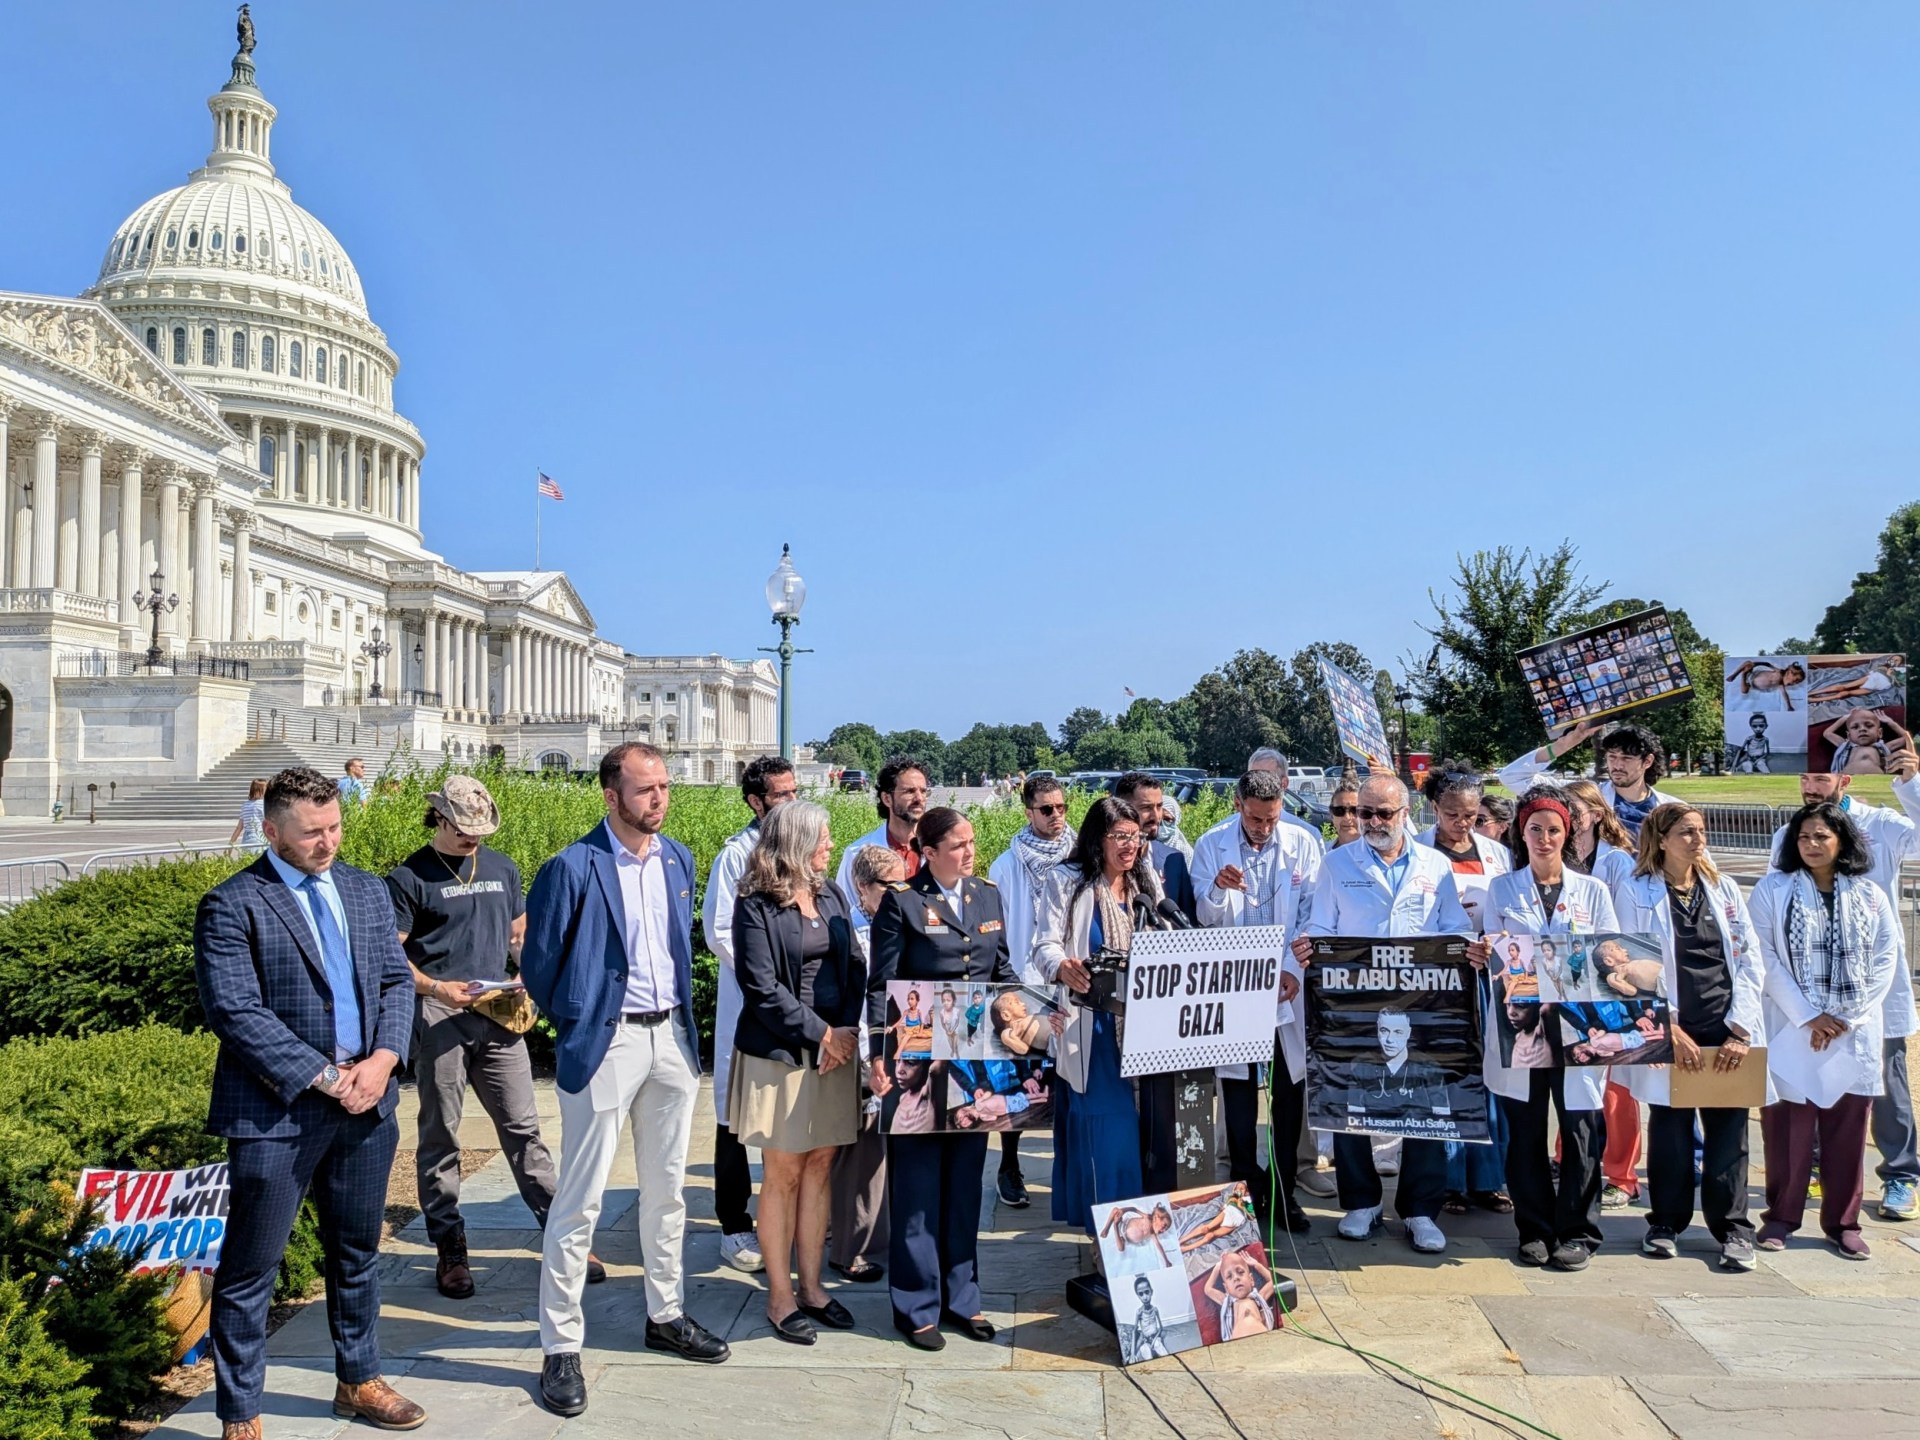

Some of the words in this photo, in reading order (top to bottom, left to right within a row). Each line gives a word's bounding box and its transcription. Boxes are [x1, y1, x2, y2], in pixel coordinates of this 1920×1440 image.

[1371, 945, 1415, 968] FREE
[1132, 963, 1182, 1001] STOP
[1185, 957, 1277, 996] STARVING
[1321, 967, 1354, 990] DR.
[1356, 968, 1397, 991] ABU
[1399, 968, 1463, 991] SAFIYA
[1178, 1002, 1224, 1039] GAZA
[1347, 1116, 1362, 1127] Dr.
[1362, 1116, 1404, 1128] Hussam
[1404, 1117, 1425, 1128] Abu
[1426, 1118, 1456, 1131] Safiya
[185, 1164, 230, 1190] WI
[84, 1170, 174, 1222] EVIL
